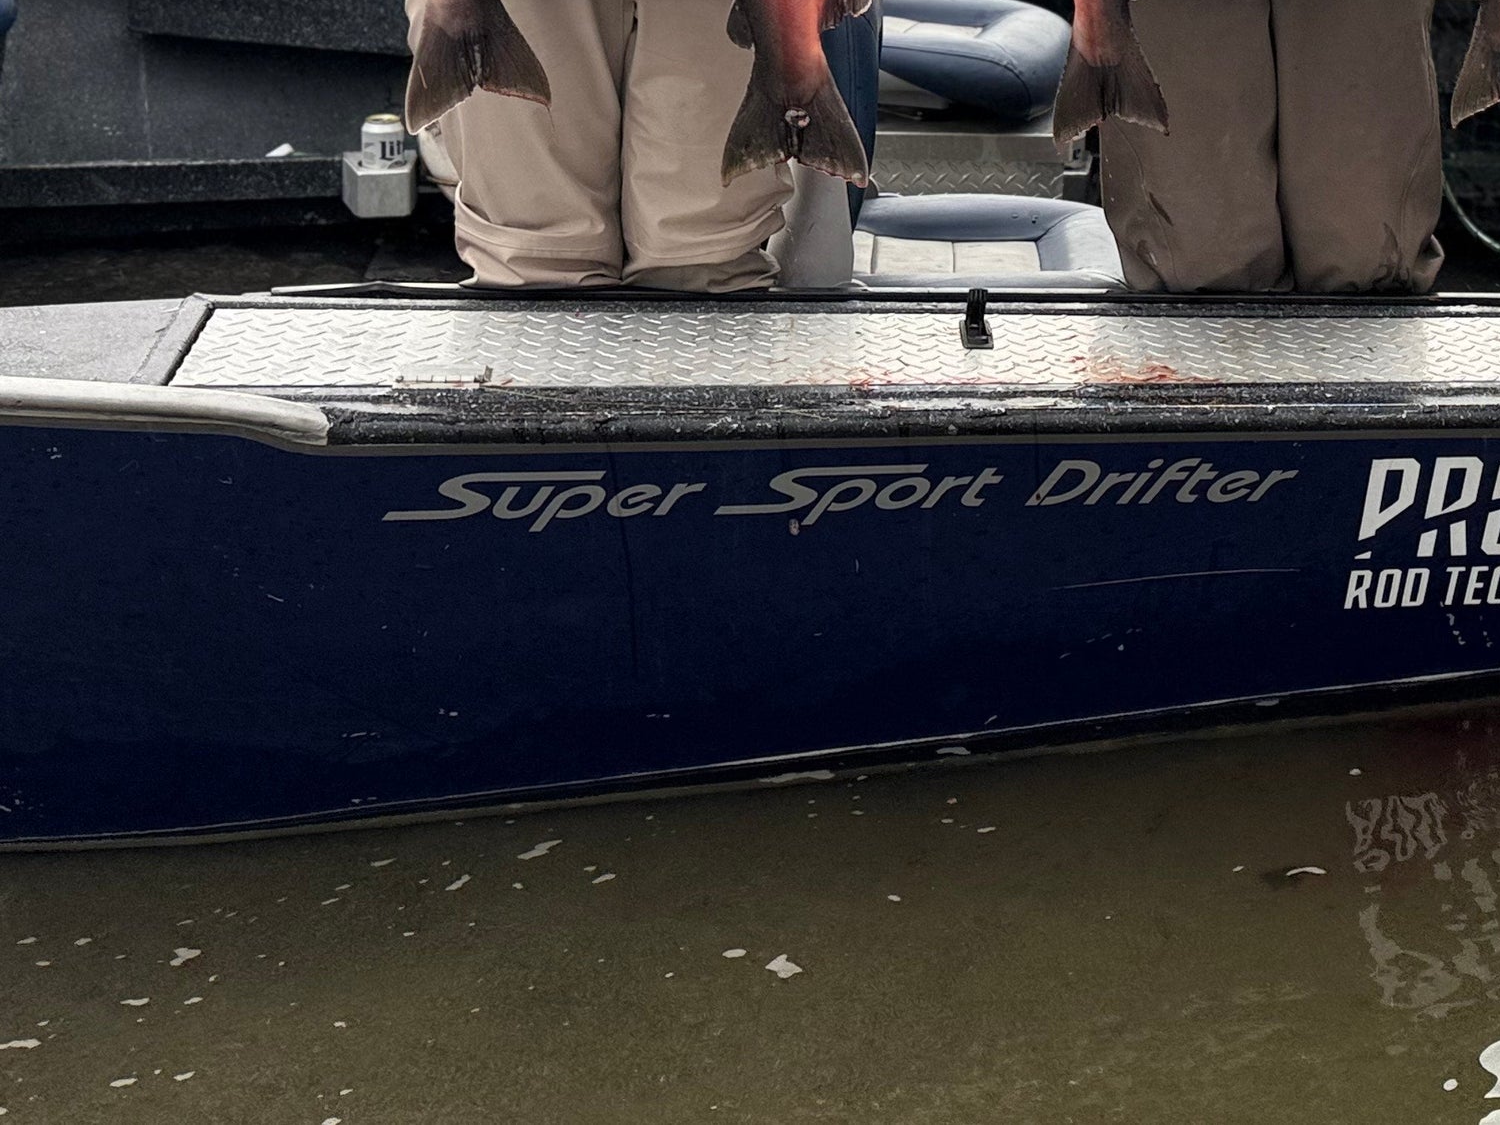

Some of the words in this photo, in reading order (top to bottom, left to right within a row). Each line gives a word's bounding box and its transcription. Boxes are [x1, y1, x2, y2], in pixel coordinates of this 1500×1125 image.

[379, 140, 403, 162] Lit
[382, 470, 706, 532] Super
[714, 464, 1004, 535] Sport
[1025, 458, 1299, 506] Drifter
[1343, 567, 1431, 610] ROD
